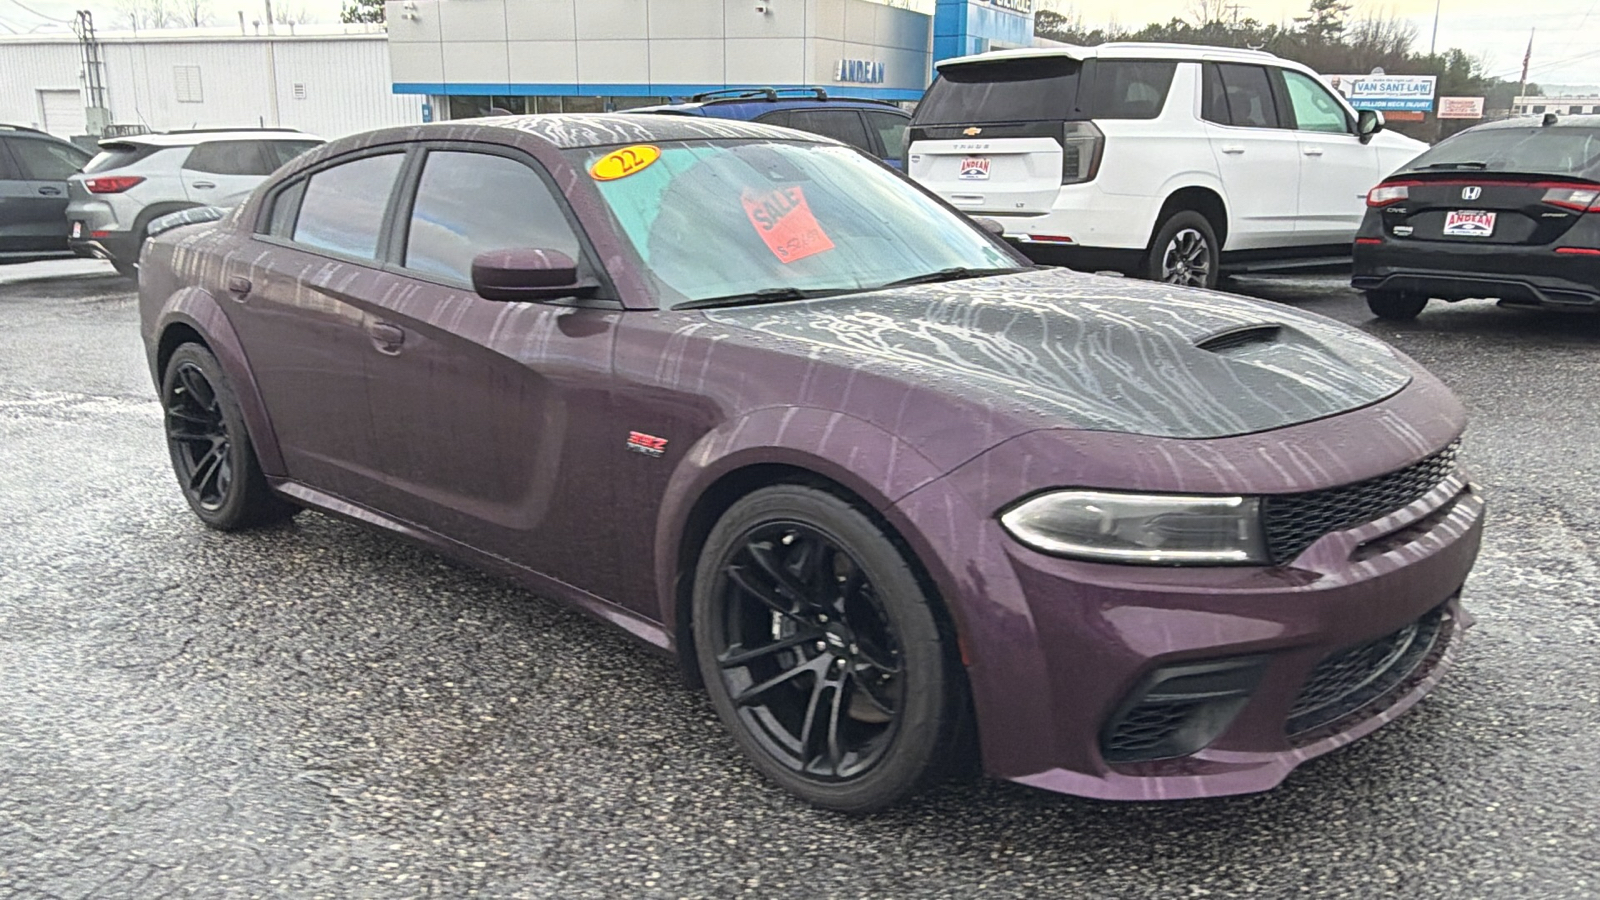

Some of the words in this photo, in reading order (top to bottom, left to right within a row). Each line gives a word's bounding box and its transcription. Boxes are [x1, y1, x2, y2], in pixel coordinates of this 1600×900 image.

[837, 59, 885, 83] ANDEAN
[1358, 82, 1377, 91] VAN
[1380, 83, 1405, 92] SANT
[1407, 83, 1429, 93] LAW
[609, 150, 645, 173] 22
[961, 160, 990, 173] ANDEAN
[753, 187, 801, 231] SALE
[1448, 213, 1493, 228] ANDEAN
